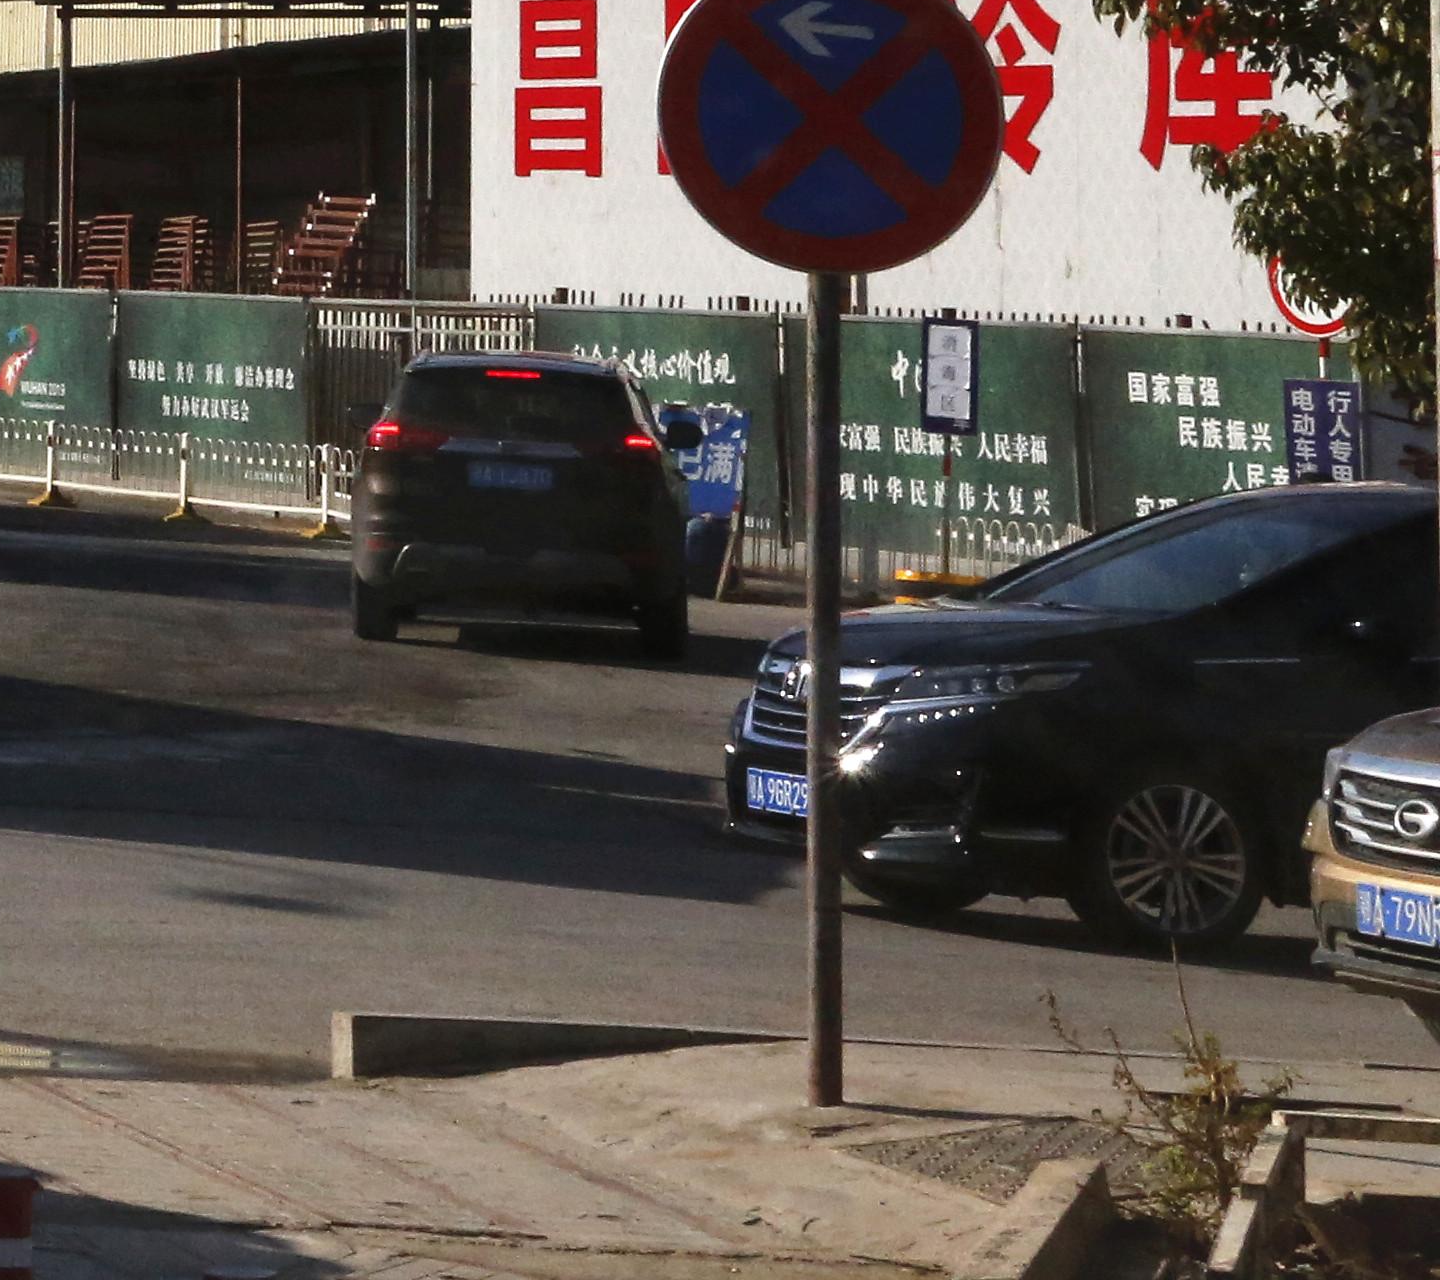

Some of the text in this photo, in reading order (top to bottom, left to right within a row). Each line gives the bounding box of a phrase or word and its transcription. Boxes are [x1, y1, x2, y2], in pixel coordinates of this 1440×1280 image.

[1127, 371, 1221, 409] 国家富强
[976, 430, 1050, 466] 人民幸福
[1177, 415, 1273, 453] 民族振兴
